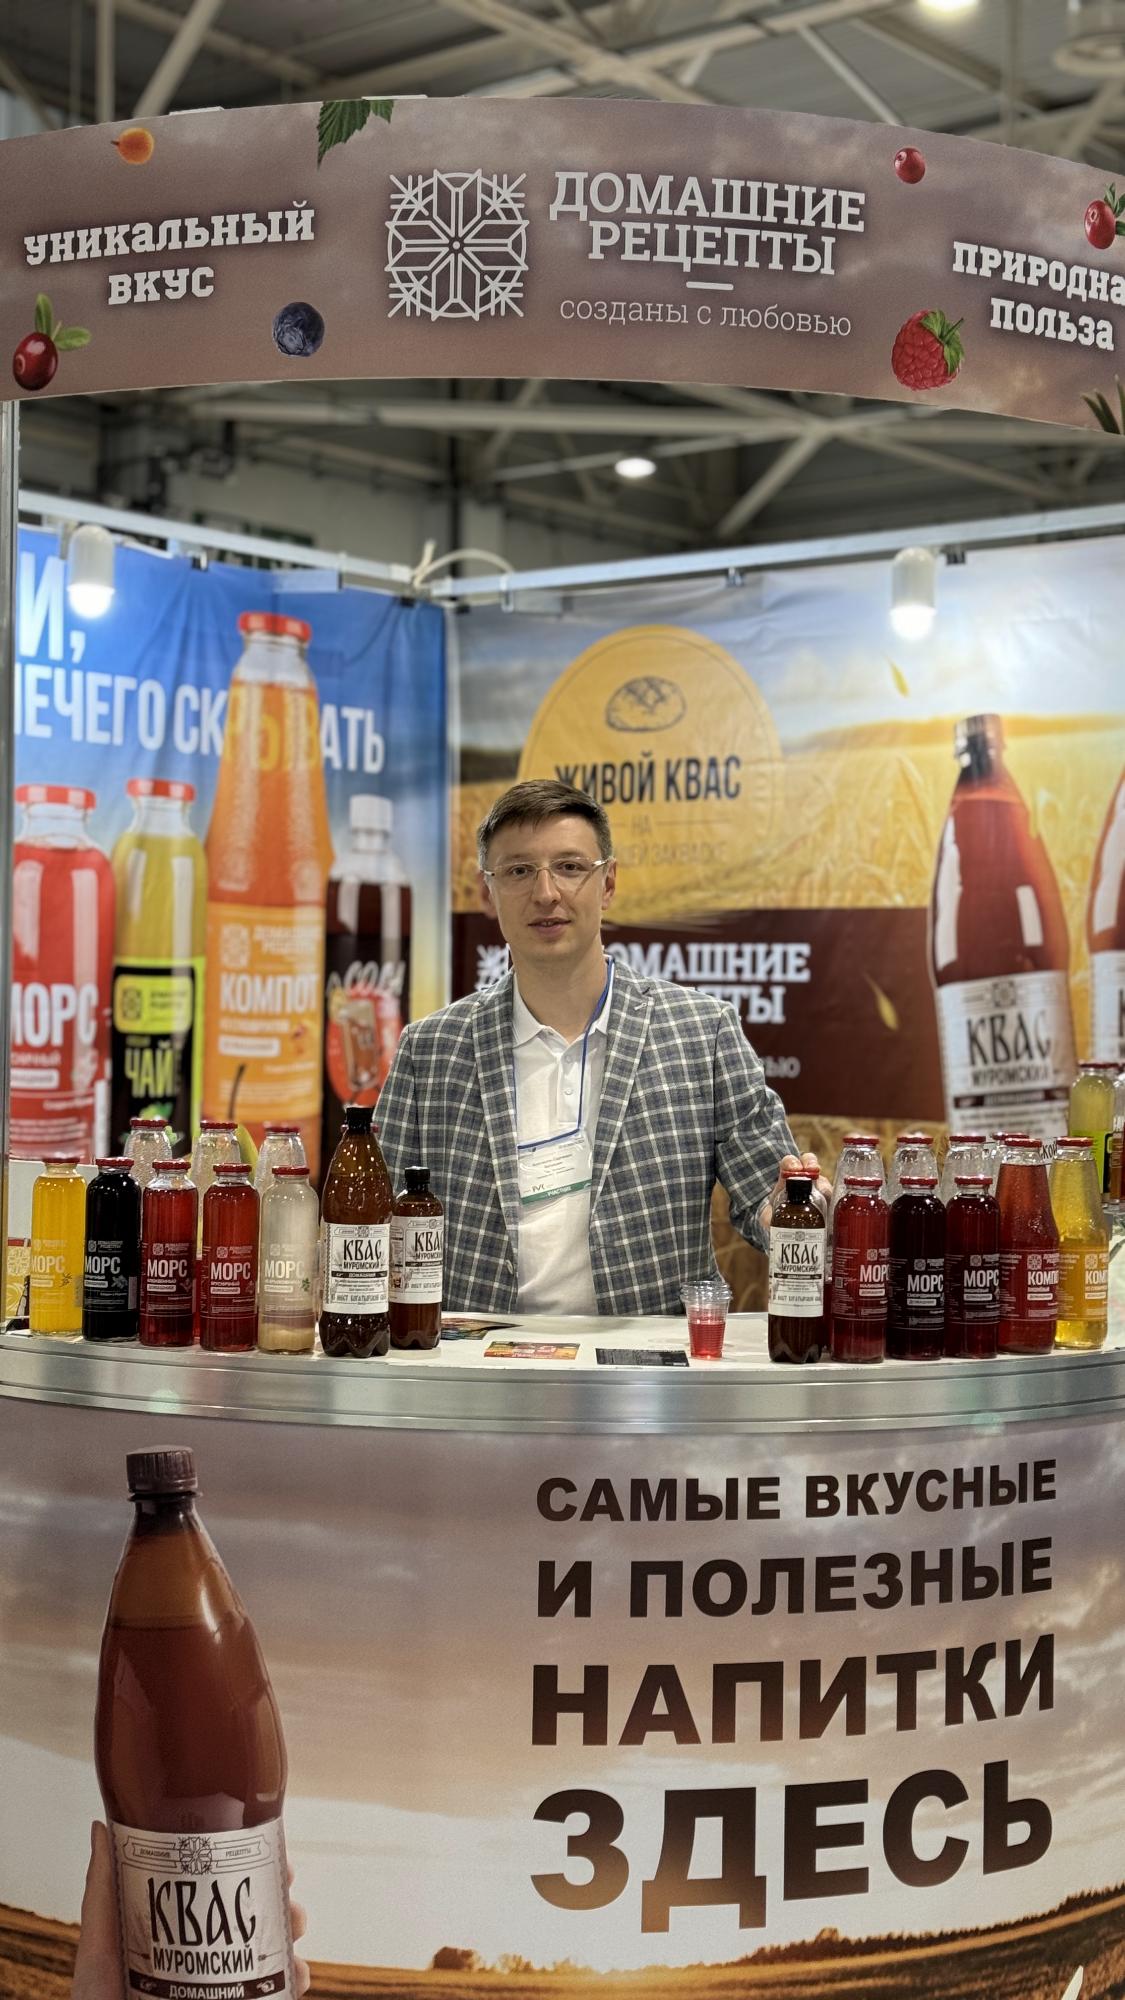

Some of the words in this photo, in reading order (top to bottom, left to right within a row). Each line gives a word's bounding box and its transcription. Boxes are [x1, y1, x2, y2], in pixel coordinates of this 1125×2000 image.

[549, 171, 865, 233] ДОМАШНИЕ
[588, 222, 836, 275] РЕЦЕПТЫ
[108, 267, 214, 305] ВКУС
[560, 299, 688, 324] созданы
[697, 305, 712, 325] с
[720, 304, 852, 336] любовью
[173, 684, 385, 774] СКРЫВАТЬ
[665, 755, 741, 802] КВАС
[220, 972, 320, 1014] КОМПОТ
[967, 1010, 1051, 1066] КВАС
[125, 1039, 175, 1098] ЧАЙ
[84, 1256, 121, 1275] МОРС
[147, 1259, 188, 1278] МОРС
[265, 1259, 305, 1279] МОРС
[343, 1239, 382, 1261] КВАС
[780, 1243, 818, 1265] КВАС
[210, 1262, 251, 1281] МОРС
[907, 1274, 944, 1293] МОРС
[963, 1269, 999, 1288] МОРС
[536, 1477, 781, 1522] САМЫЕ
[805, 1459, 1057, 1519] ВКУСНЫЕ
[537, 1560, 592, 1618] И
[629, 1536, 1053, 1618] ПОЛЕЗНЫЕ
[531, 1633, 1055, 1746] НАПИТКИ
[530, 1759, 1053, 1933] ЗДЕСЬ
[147, 1876, 256, 1946] КВАС
[153, 1944, 254, 1975] МУРОМСКИЙ
[169, 1983, 245, 2000] ДОМАШНИЙ
